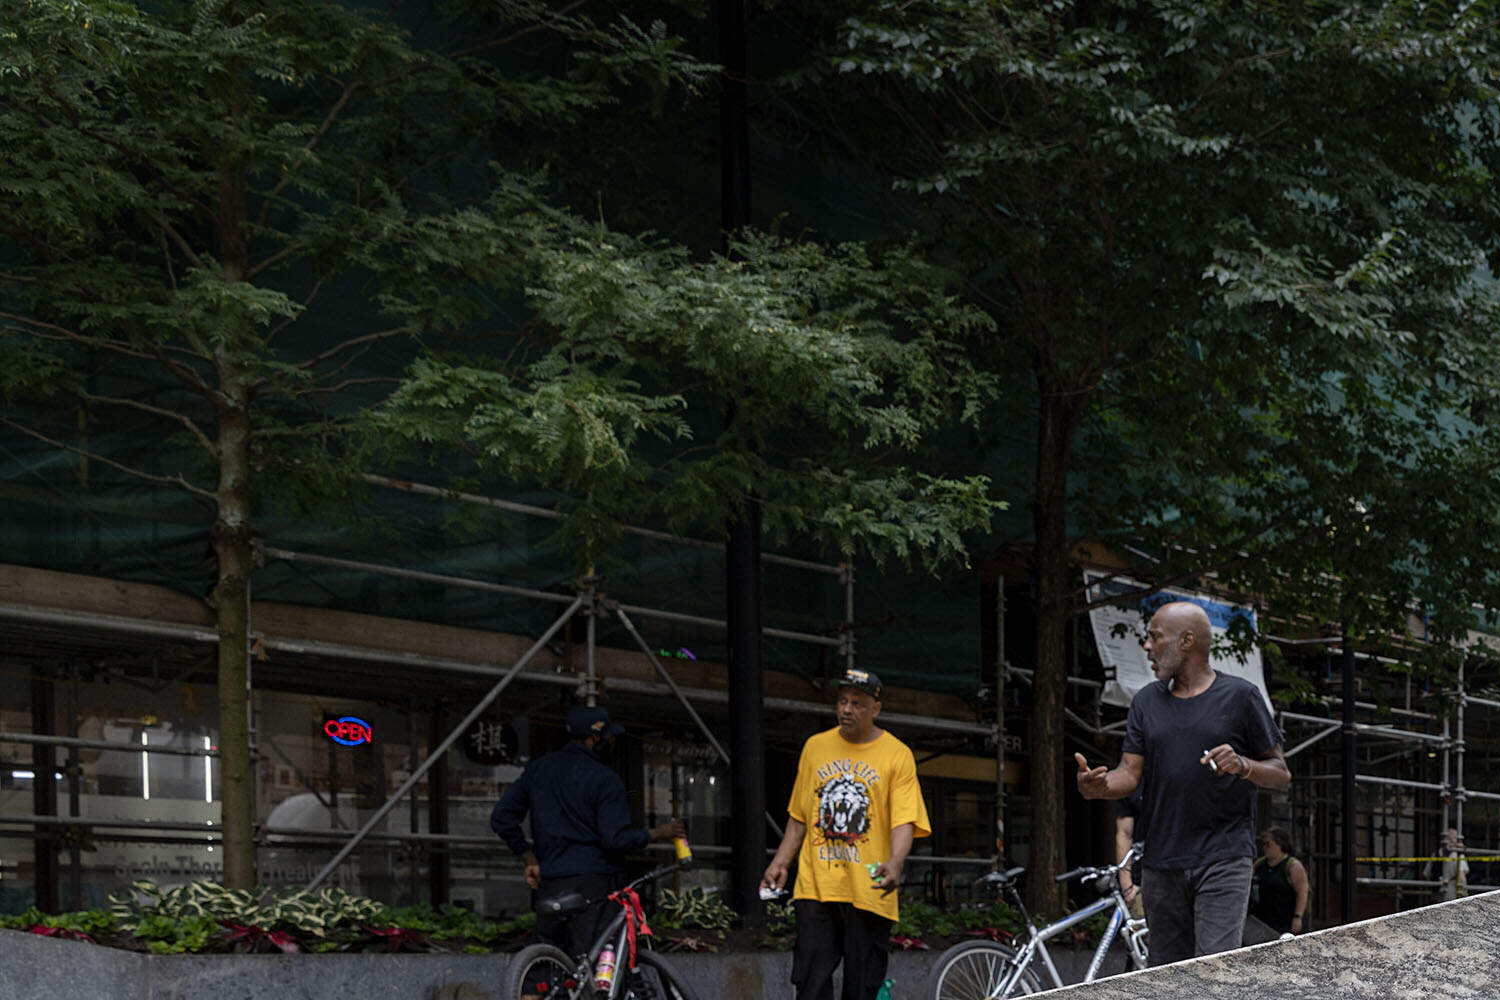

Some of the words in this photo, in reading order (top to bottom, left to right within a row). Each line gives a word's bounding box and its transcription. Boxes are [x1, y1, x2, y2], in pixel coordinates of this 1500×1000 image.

[324, 719, 372, 744] OPEN
[817, 758, 852, 781] KING
[853, 761, 881, 787] LIFE
